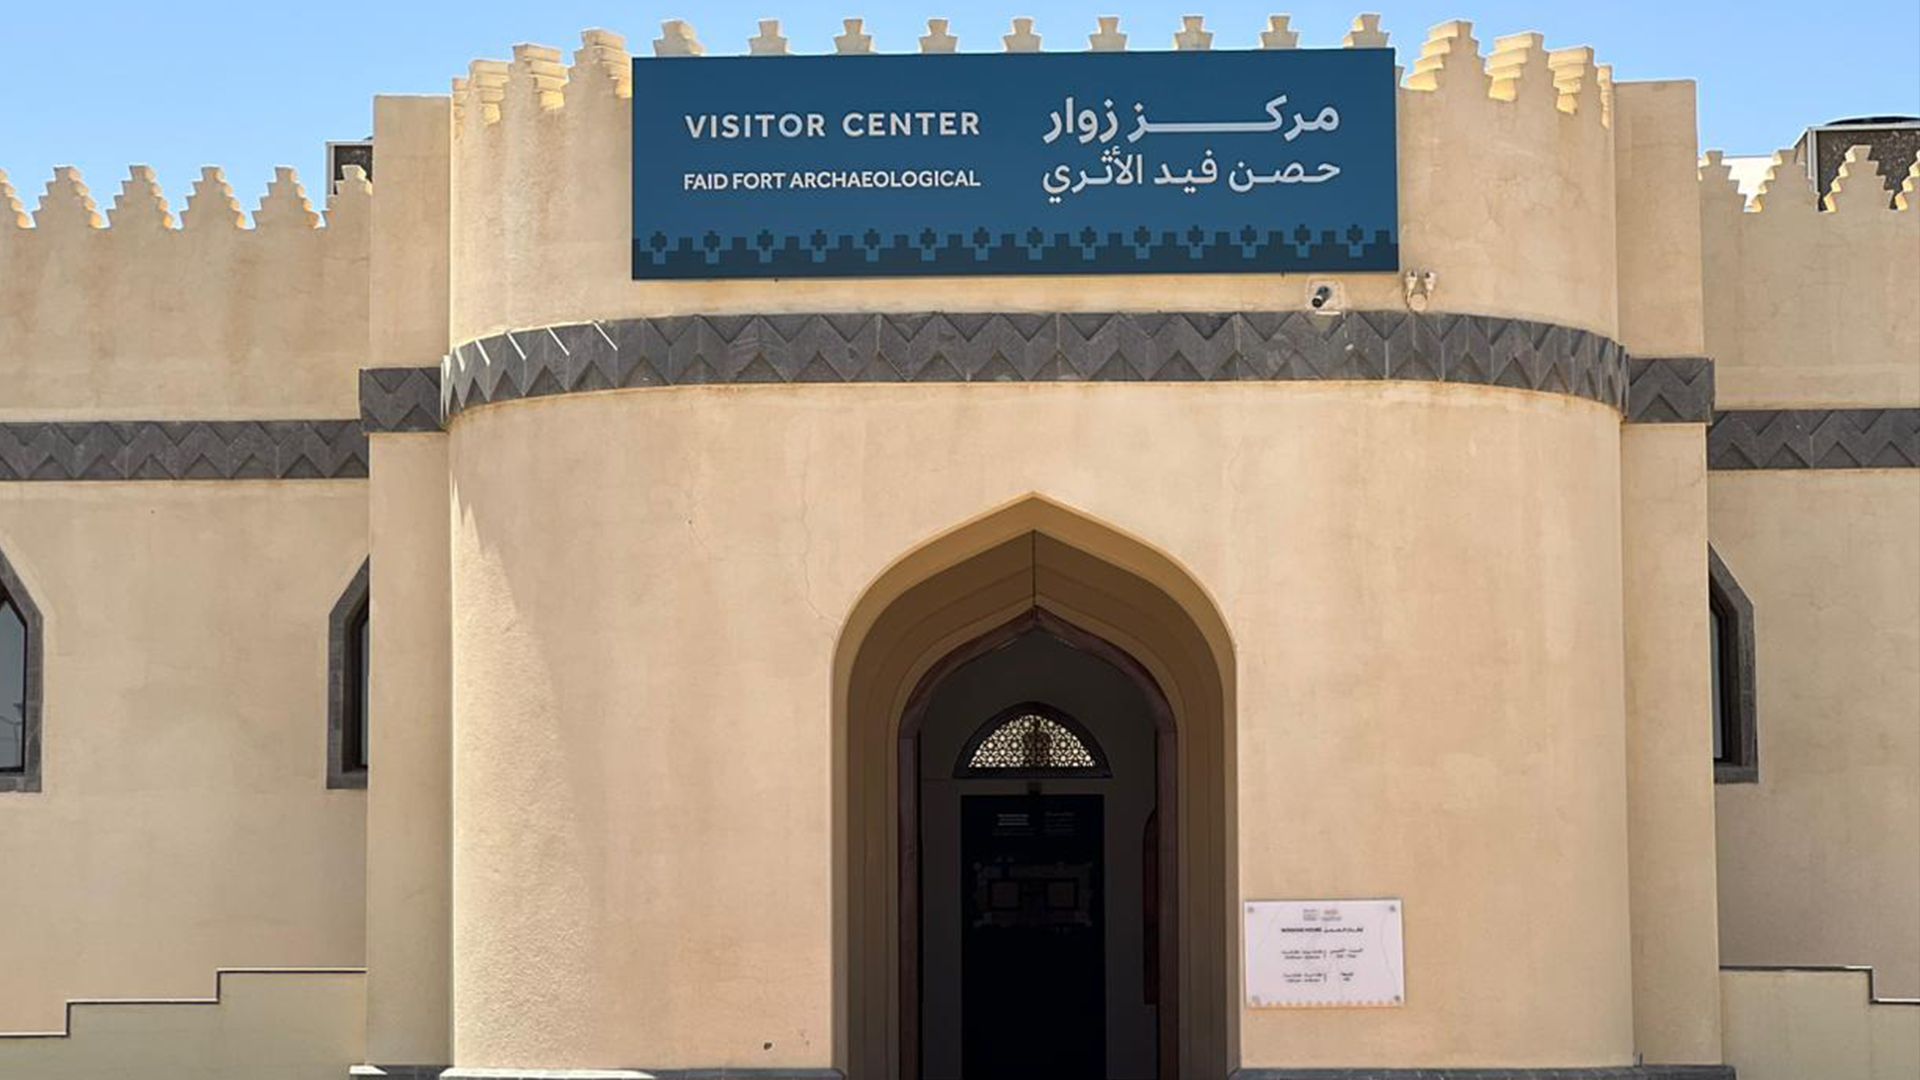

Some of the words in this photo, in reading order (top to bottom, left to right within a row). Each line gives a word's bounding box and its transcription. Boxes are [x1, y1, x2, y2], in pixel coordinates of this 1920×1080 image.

[684, 113, 826, 139] VISITOR
[842, 111, 980, 137] CENTER
[1042, 96, 1119, 143] زوار
[683, 172, 729, 191] FAID
[732, 172, 787, 190] FORT
[788, 169, 982, 189] ARCHAEOLOGICAL
[1042, 145, 1143, 204] الأثري
[1153, 149, 1218, 194] فيد
[1228, 161, 1341, 193] حصن
